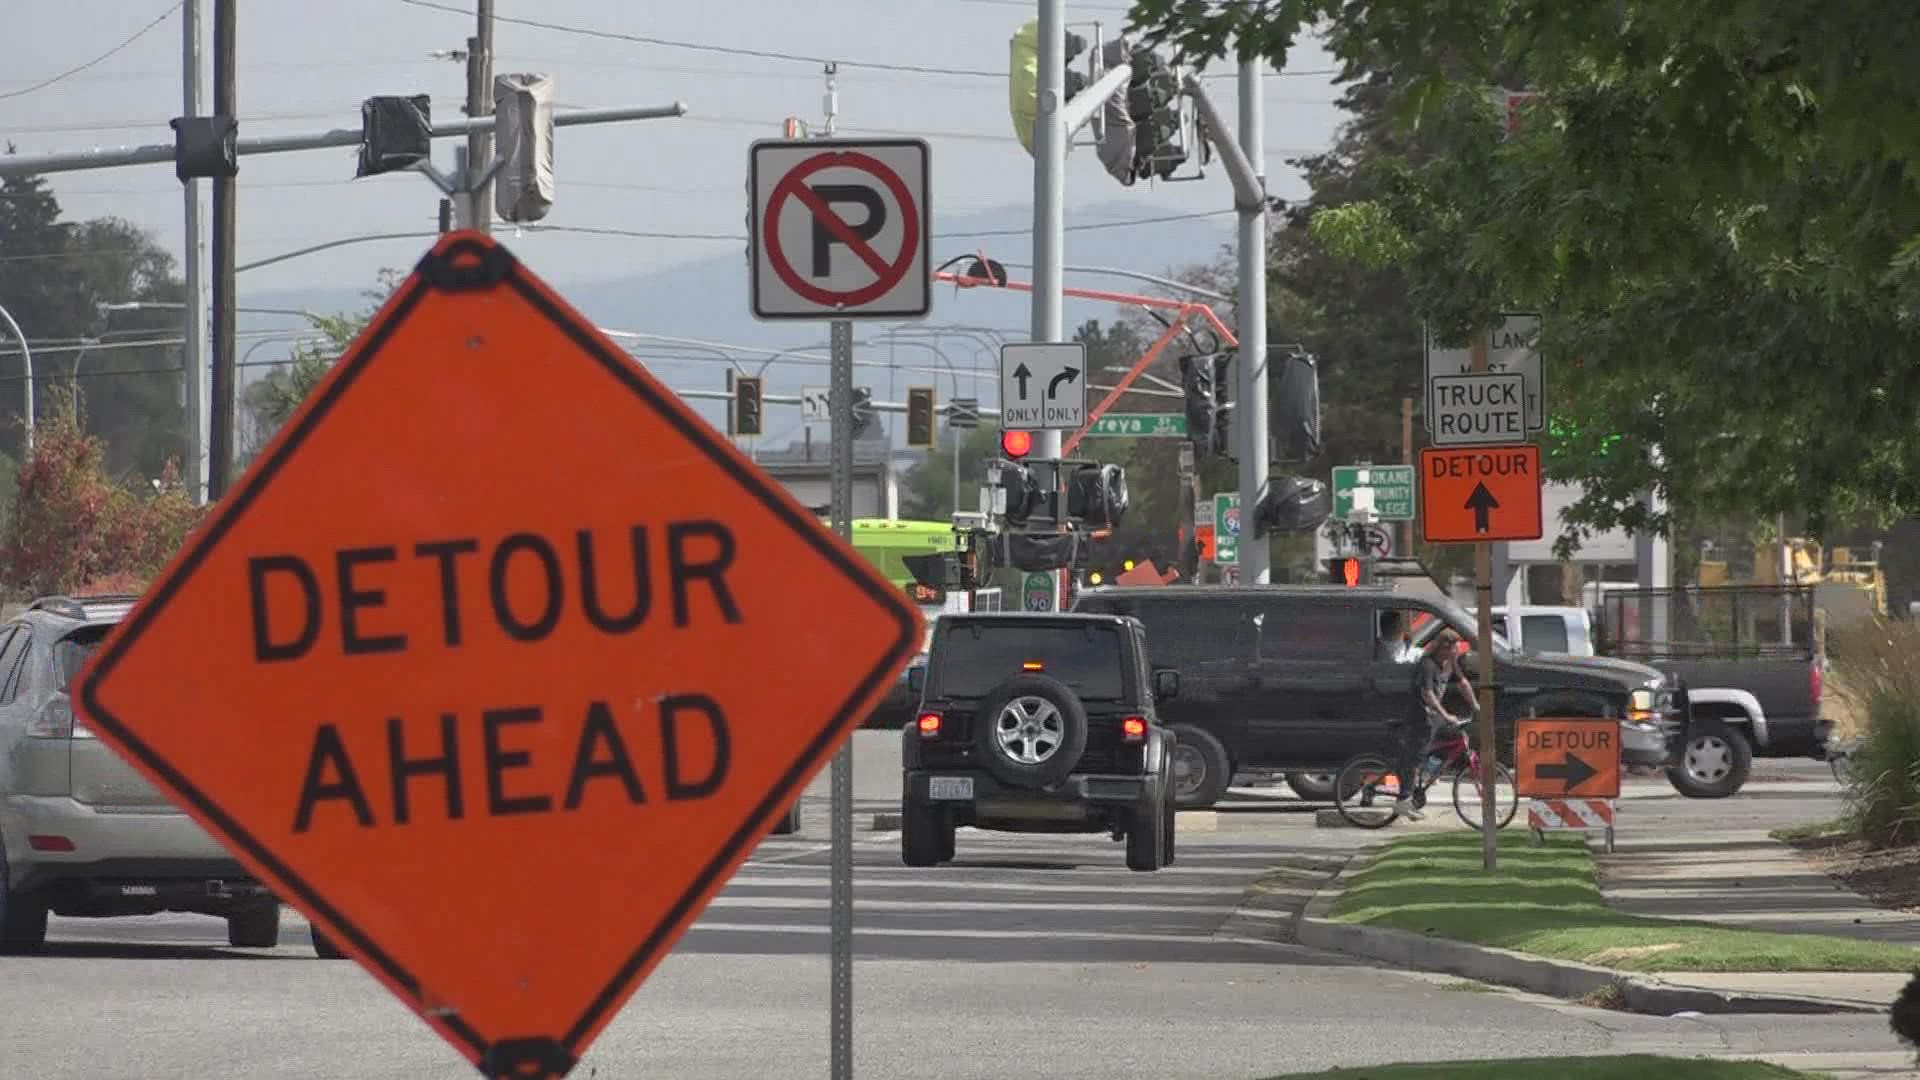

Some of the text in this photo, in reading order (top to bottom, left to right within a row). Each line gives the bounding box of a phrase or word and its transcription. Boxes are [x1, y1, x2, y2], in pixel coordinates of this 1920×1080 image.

[1460, 363, 1508, 373] MST
[1436, 383, 1518, 407] TRUCK
[1006, 407, 1039, 422] ONLY
[1047, 407, 1080, 422] ONLY
[1440, 411, 1521, 435] ROUTE
[1097, 418, 1142, 435] reya
[1431, 453, 1529, 478] DETOUR
[1370, 470, 1410, 484] OKANE
[247, 519, 743, 664] DETOUR
[1526, 730, 1610, 749] DETOUR
[291, 692, 732, 834] AHEAD
